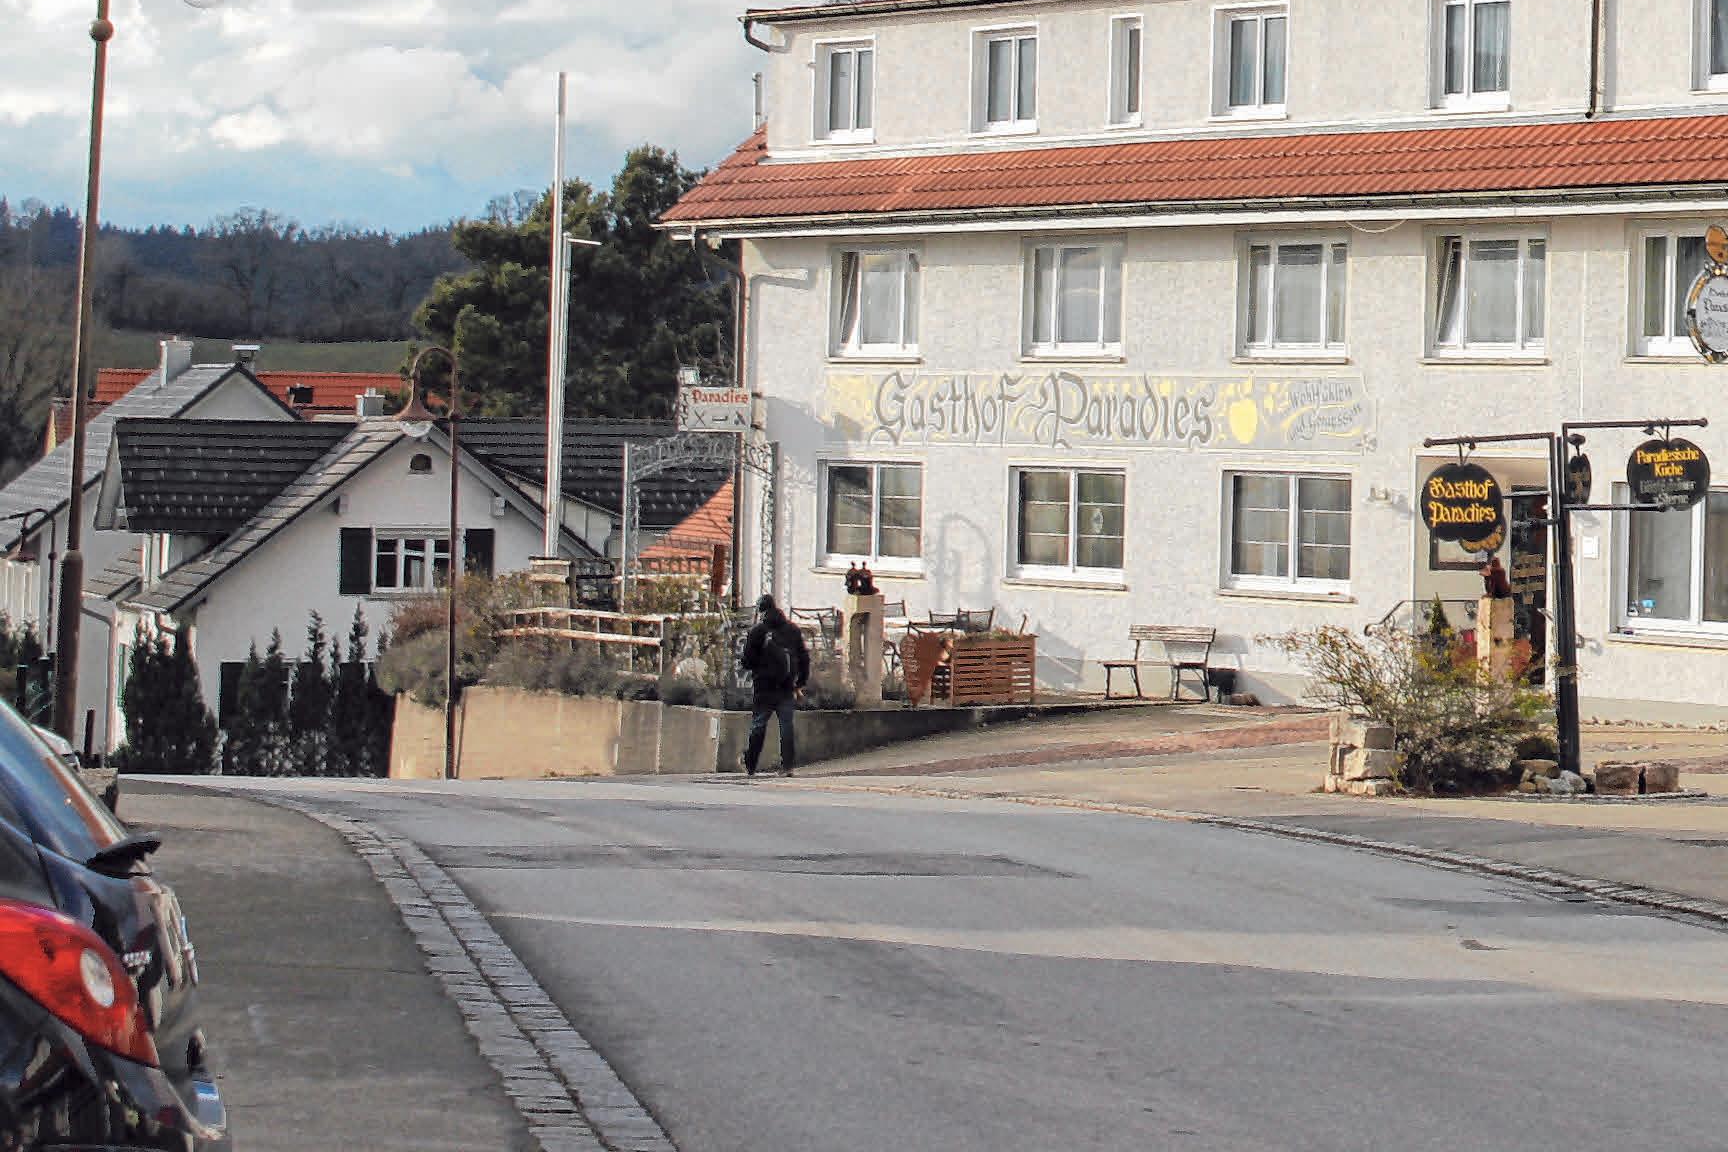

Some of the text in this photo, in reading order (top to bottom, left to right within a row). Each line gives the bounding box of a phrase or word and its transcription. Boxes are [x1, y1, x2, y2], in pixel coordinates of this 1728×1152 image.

[691, 389, 749, 405] Paradies
[870, 370, 1215, 448] Gasthof Paradies
[1636, 447, 1699, 464] Paradiesische
[1654, 463, 1684, 478] Küche
[1428, 476, 1495, 501] Gasthof
[1428, 500, 1497, 528] Paradies
